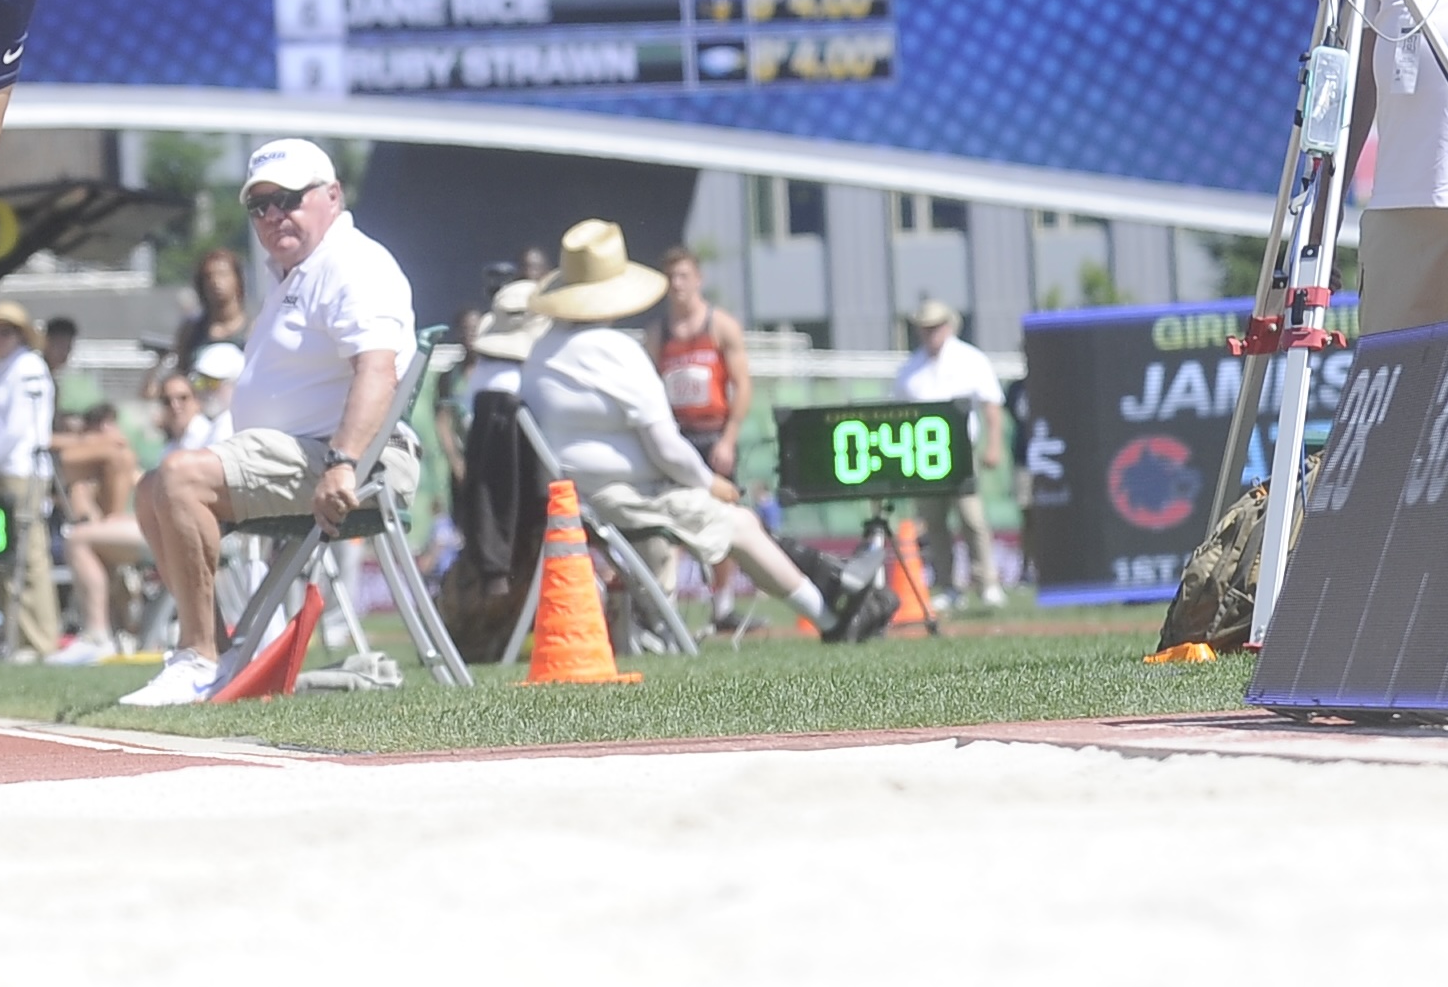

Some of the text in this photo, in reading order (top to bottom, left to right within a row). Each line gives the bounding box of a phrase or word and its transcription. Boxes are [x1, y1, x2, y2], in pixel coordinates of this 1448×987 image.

[461, 44, 638, 84] STRAWN
[1153, 313, 1249, 352] GIRL
[833, 416, 952, 485] 0:48
